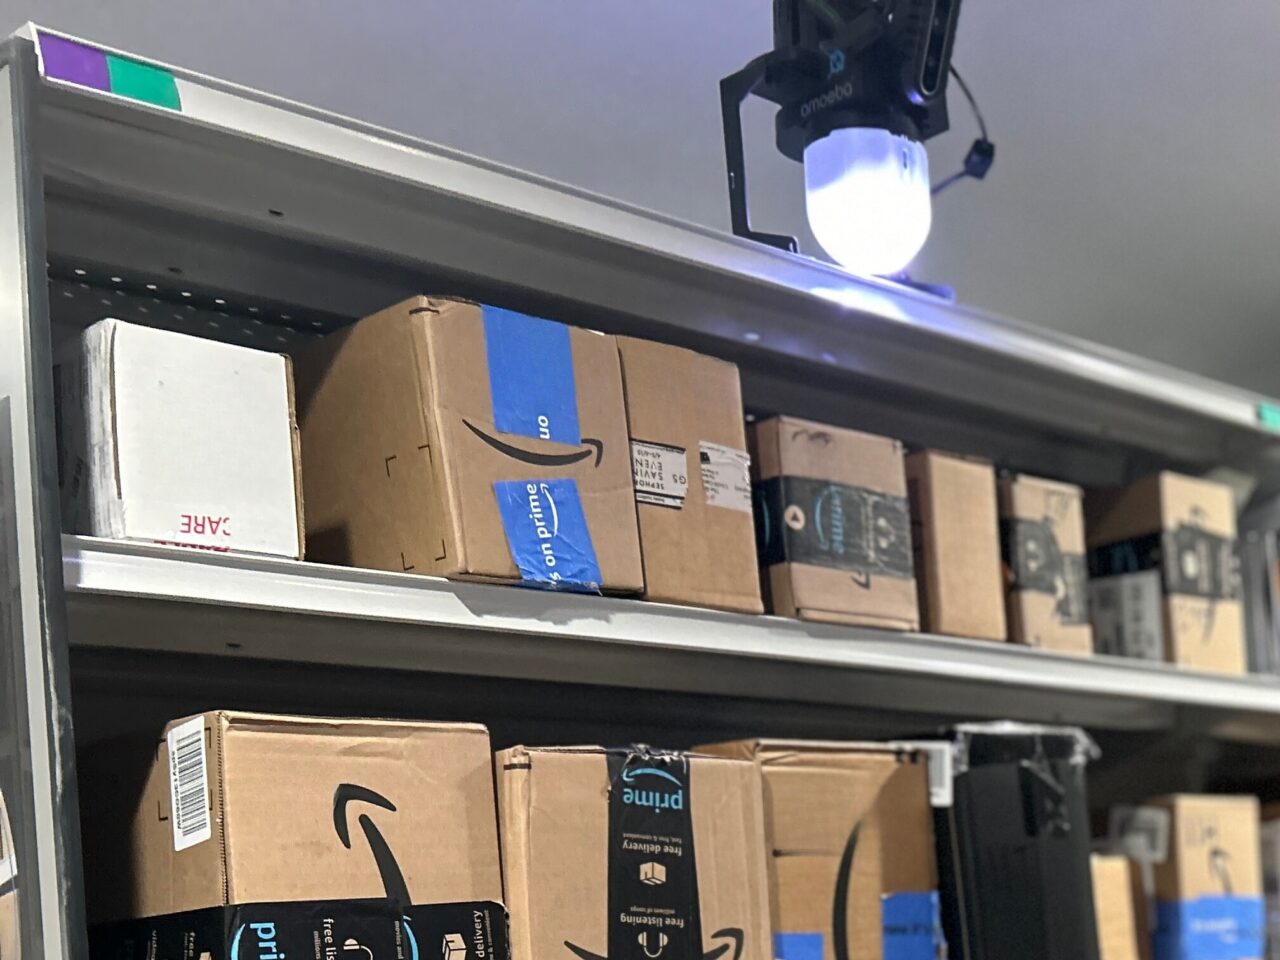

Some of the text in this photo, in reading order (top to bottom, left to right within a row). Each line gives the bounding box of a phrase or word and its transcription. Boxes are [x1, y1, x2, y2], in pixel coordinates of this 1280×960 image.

[527, 484, 552, 539] prime
[540, 543, 556, 566] on
[623, 788, 683, 813] prime
[622, 840, 682, 856] free delivery
[323, 918, 334, 943] free
[620, 912, 684, 928] free listening
[473, 910, 486, 960] delivery
